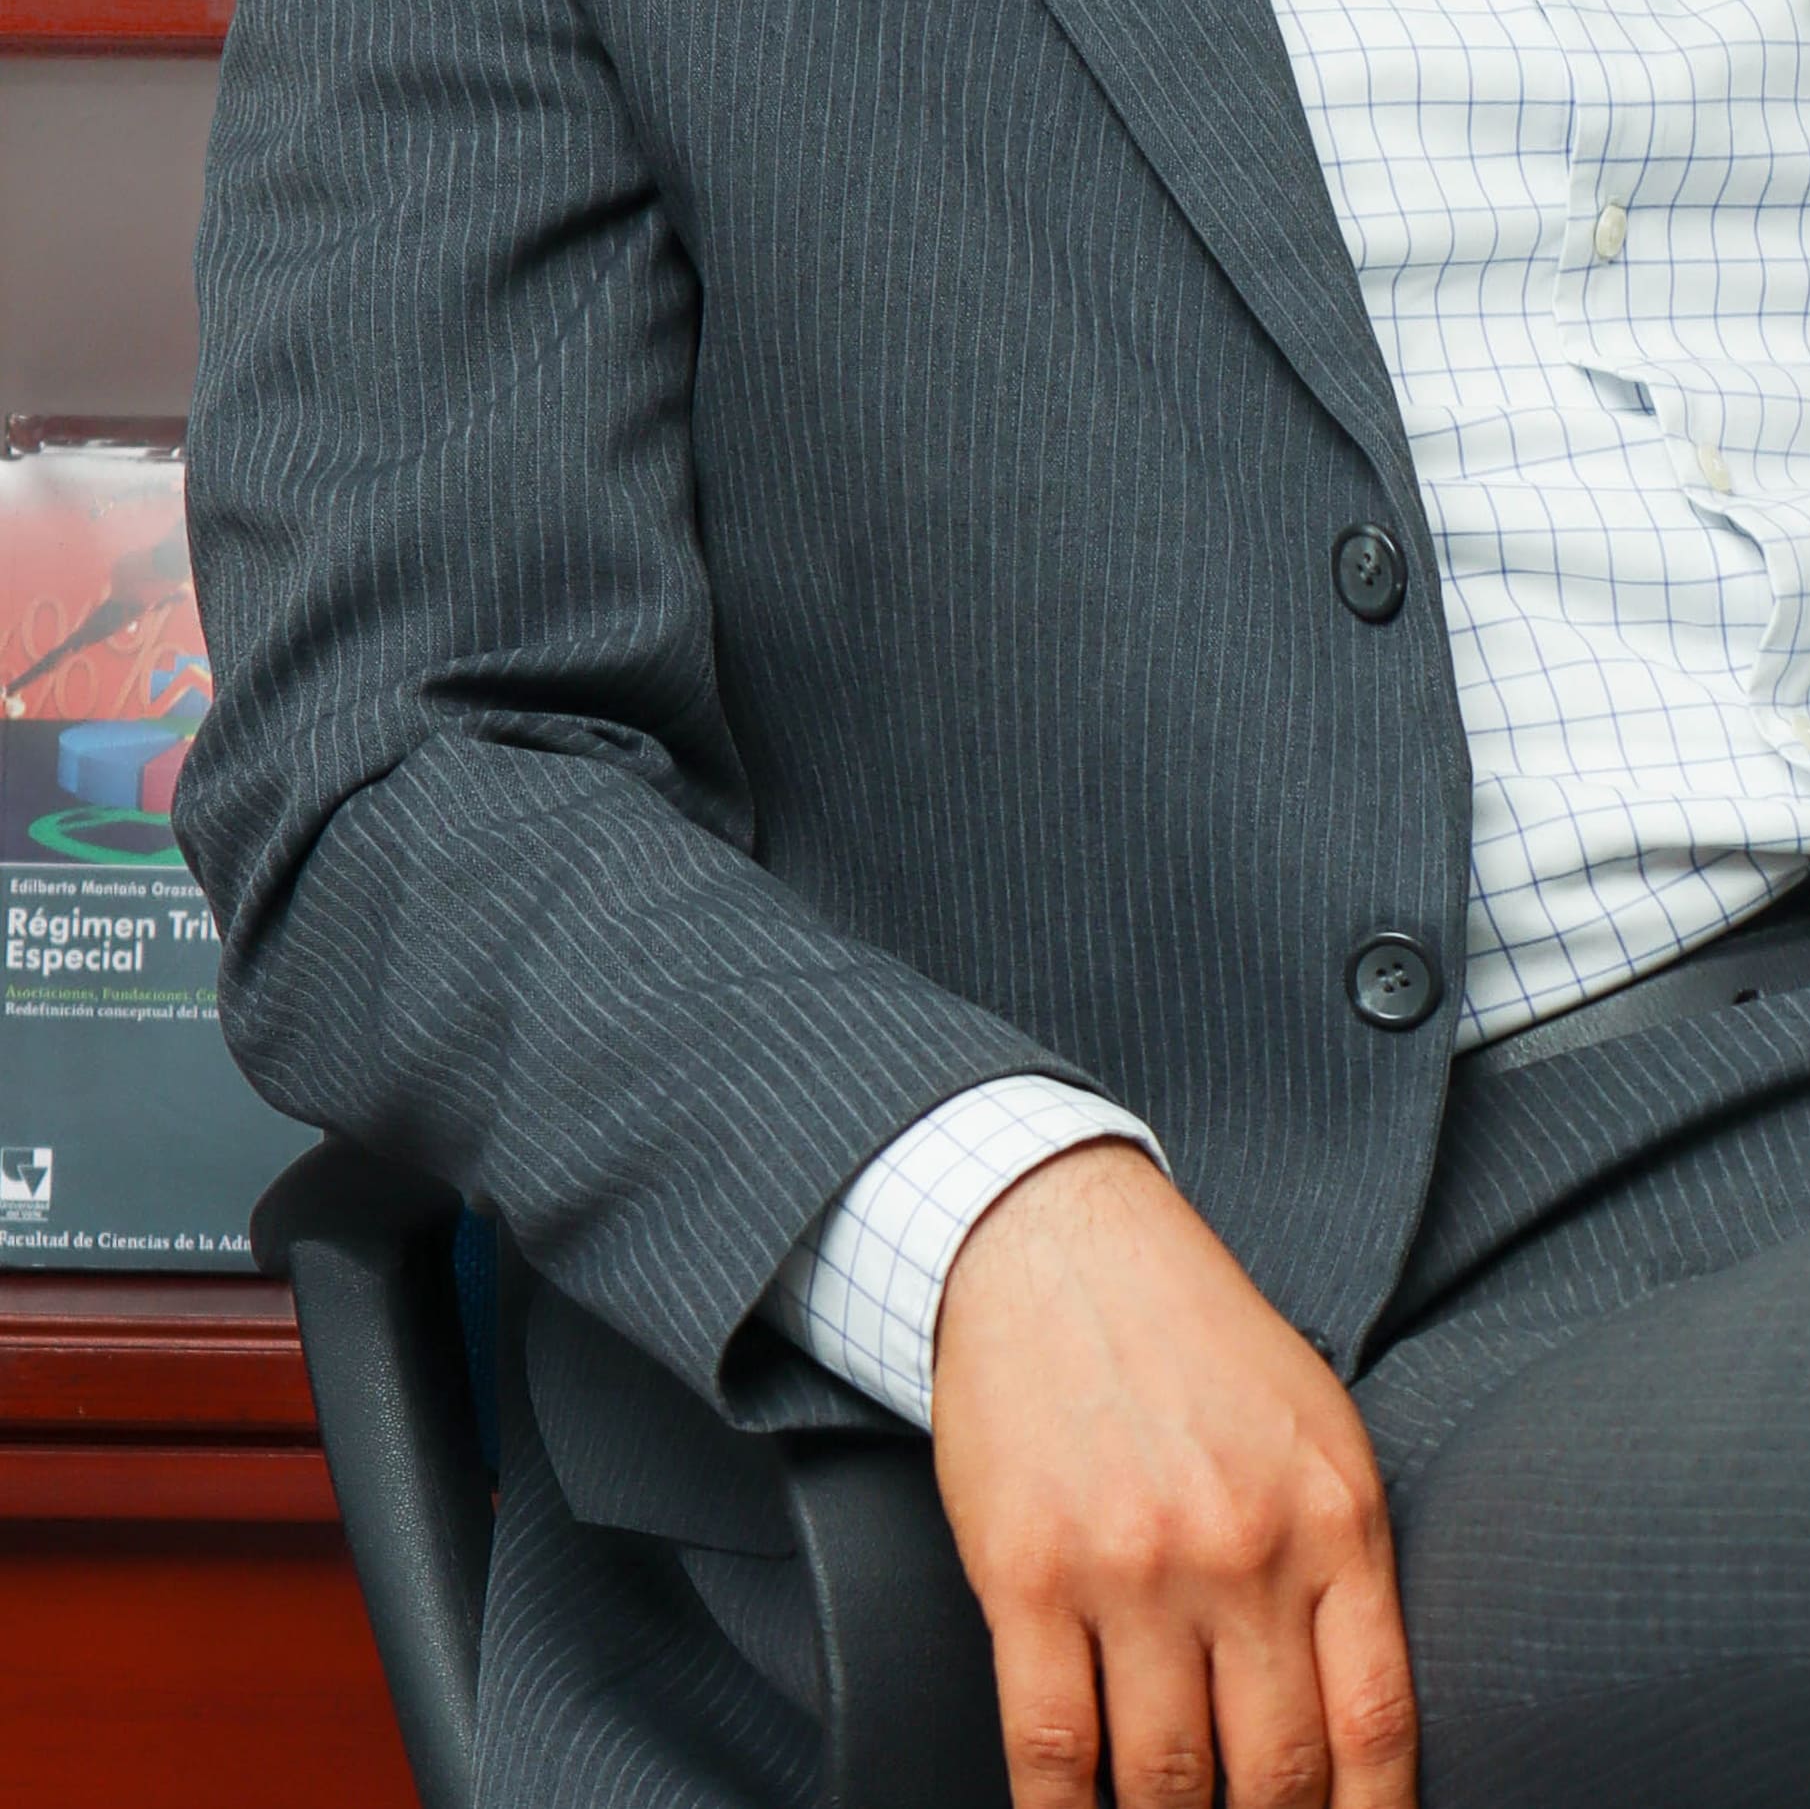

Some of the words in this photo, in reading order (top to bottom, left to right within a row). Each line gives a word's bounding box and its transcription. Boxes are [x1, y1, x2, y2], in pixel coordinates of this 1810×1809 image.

[10, 878, 77, 895] Edilberto
[81, 880, 147, 896] Montaño
[7, 906, 156, 945] Régimen
[6, 939, 144, 977] Especial
[5, 1002, 94, 1017] Redefinición
[97, 1004, 174, 1021] conceptual
[176, 1004, 199, 1019] del
[73, 1230, 94, 1249] de
[98, 1232, 170, 1251] Ciencias
[174, 1233, 195, 1251] de
[199, 1234, 214, 1251] la
